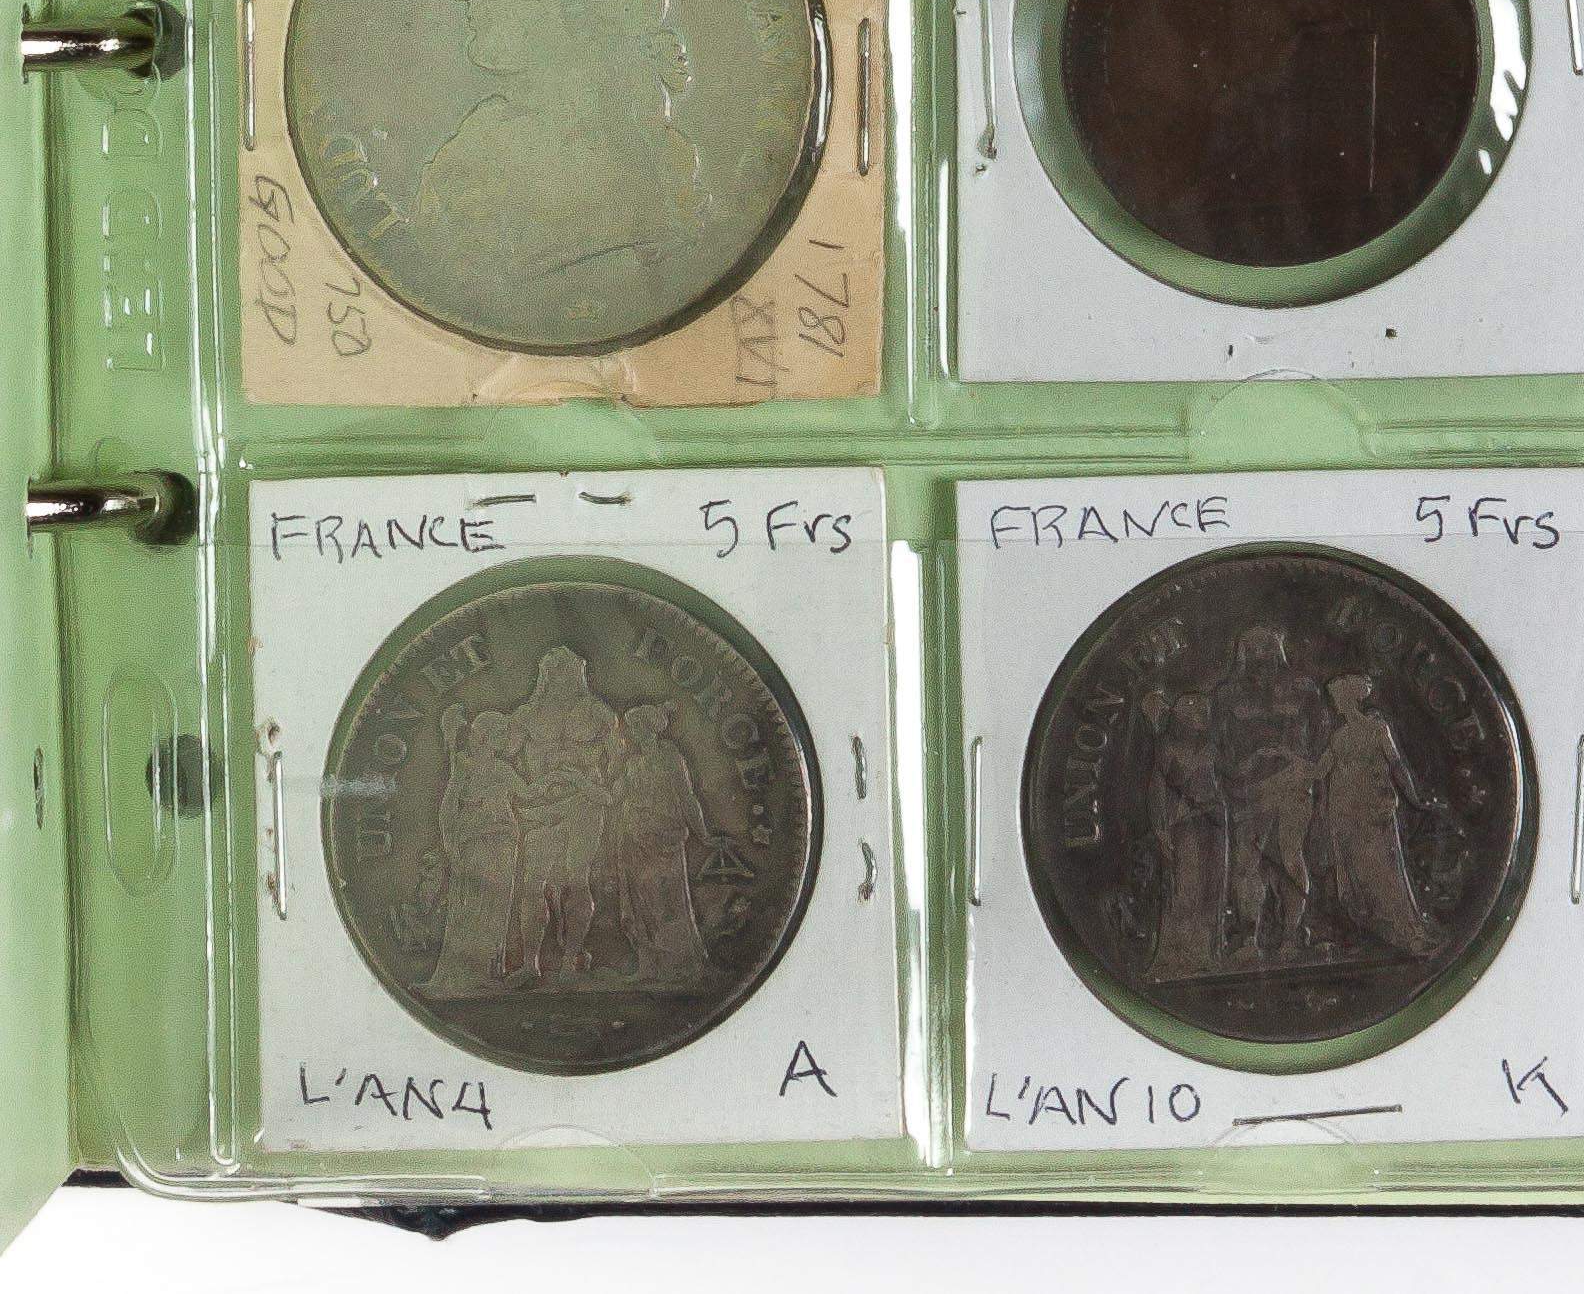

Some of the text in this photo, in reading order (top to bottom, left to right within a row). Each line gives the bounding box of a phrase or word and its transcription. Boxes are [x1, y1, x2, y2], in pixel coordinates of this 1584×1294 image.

[270, 511, 511, 568] FRANCE
[698, 498, 739, 559] 5
[990, 495, 1230, 556] FRANCE
[1415, 494, 1451, 544] 5
[778, 1039, 838, 1098] A
